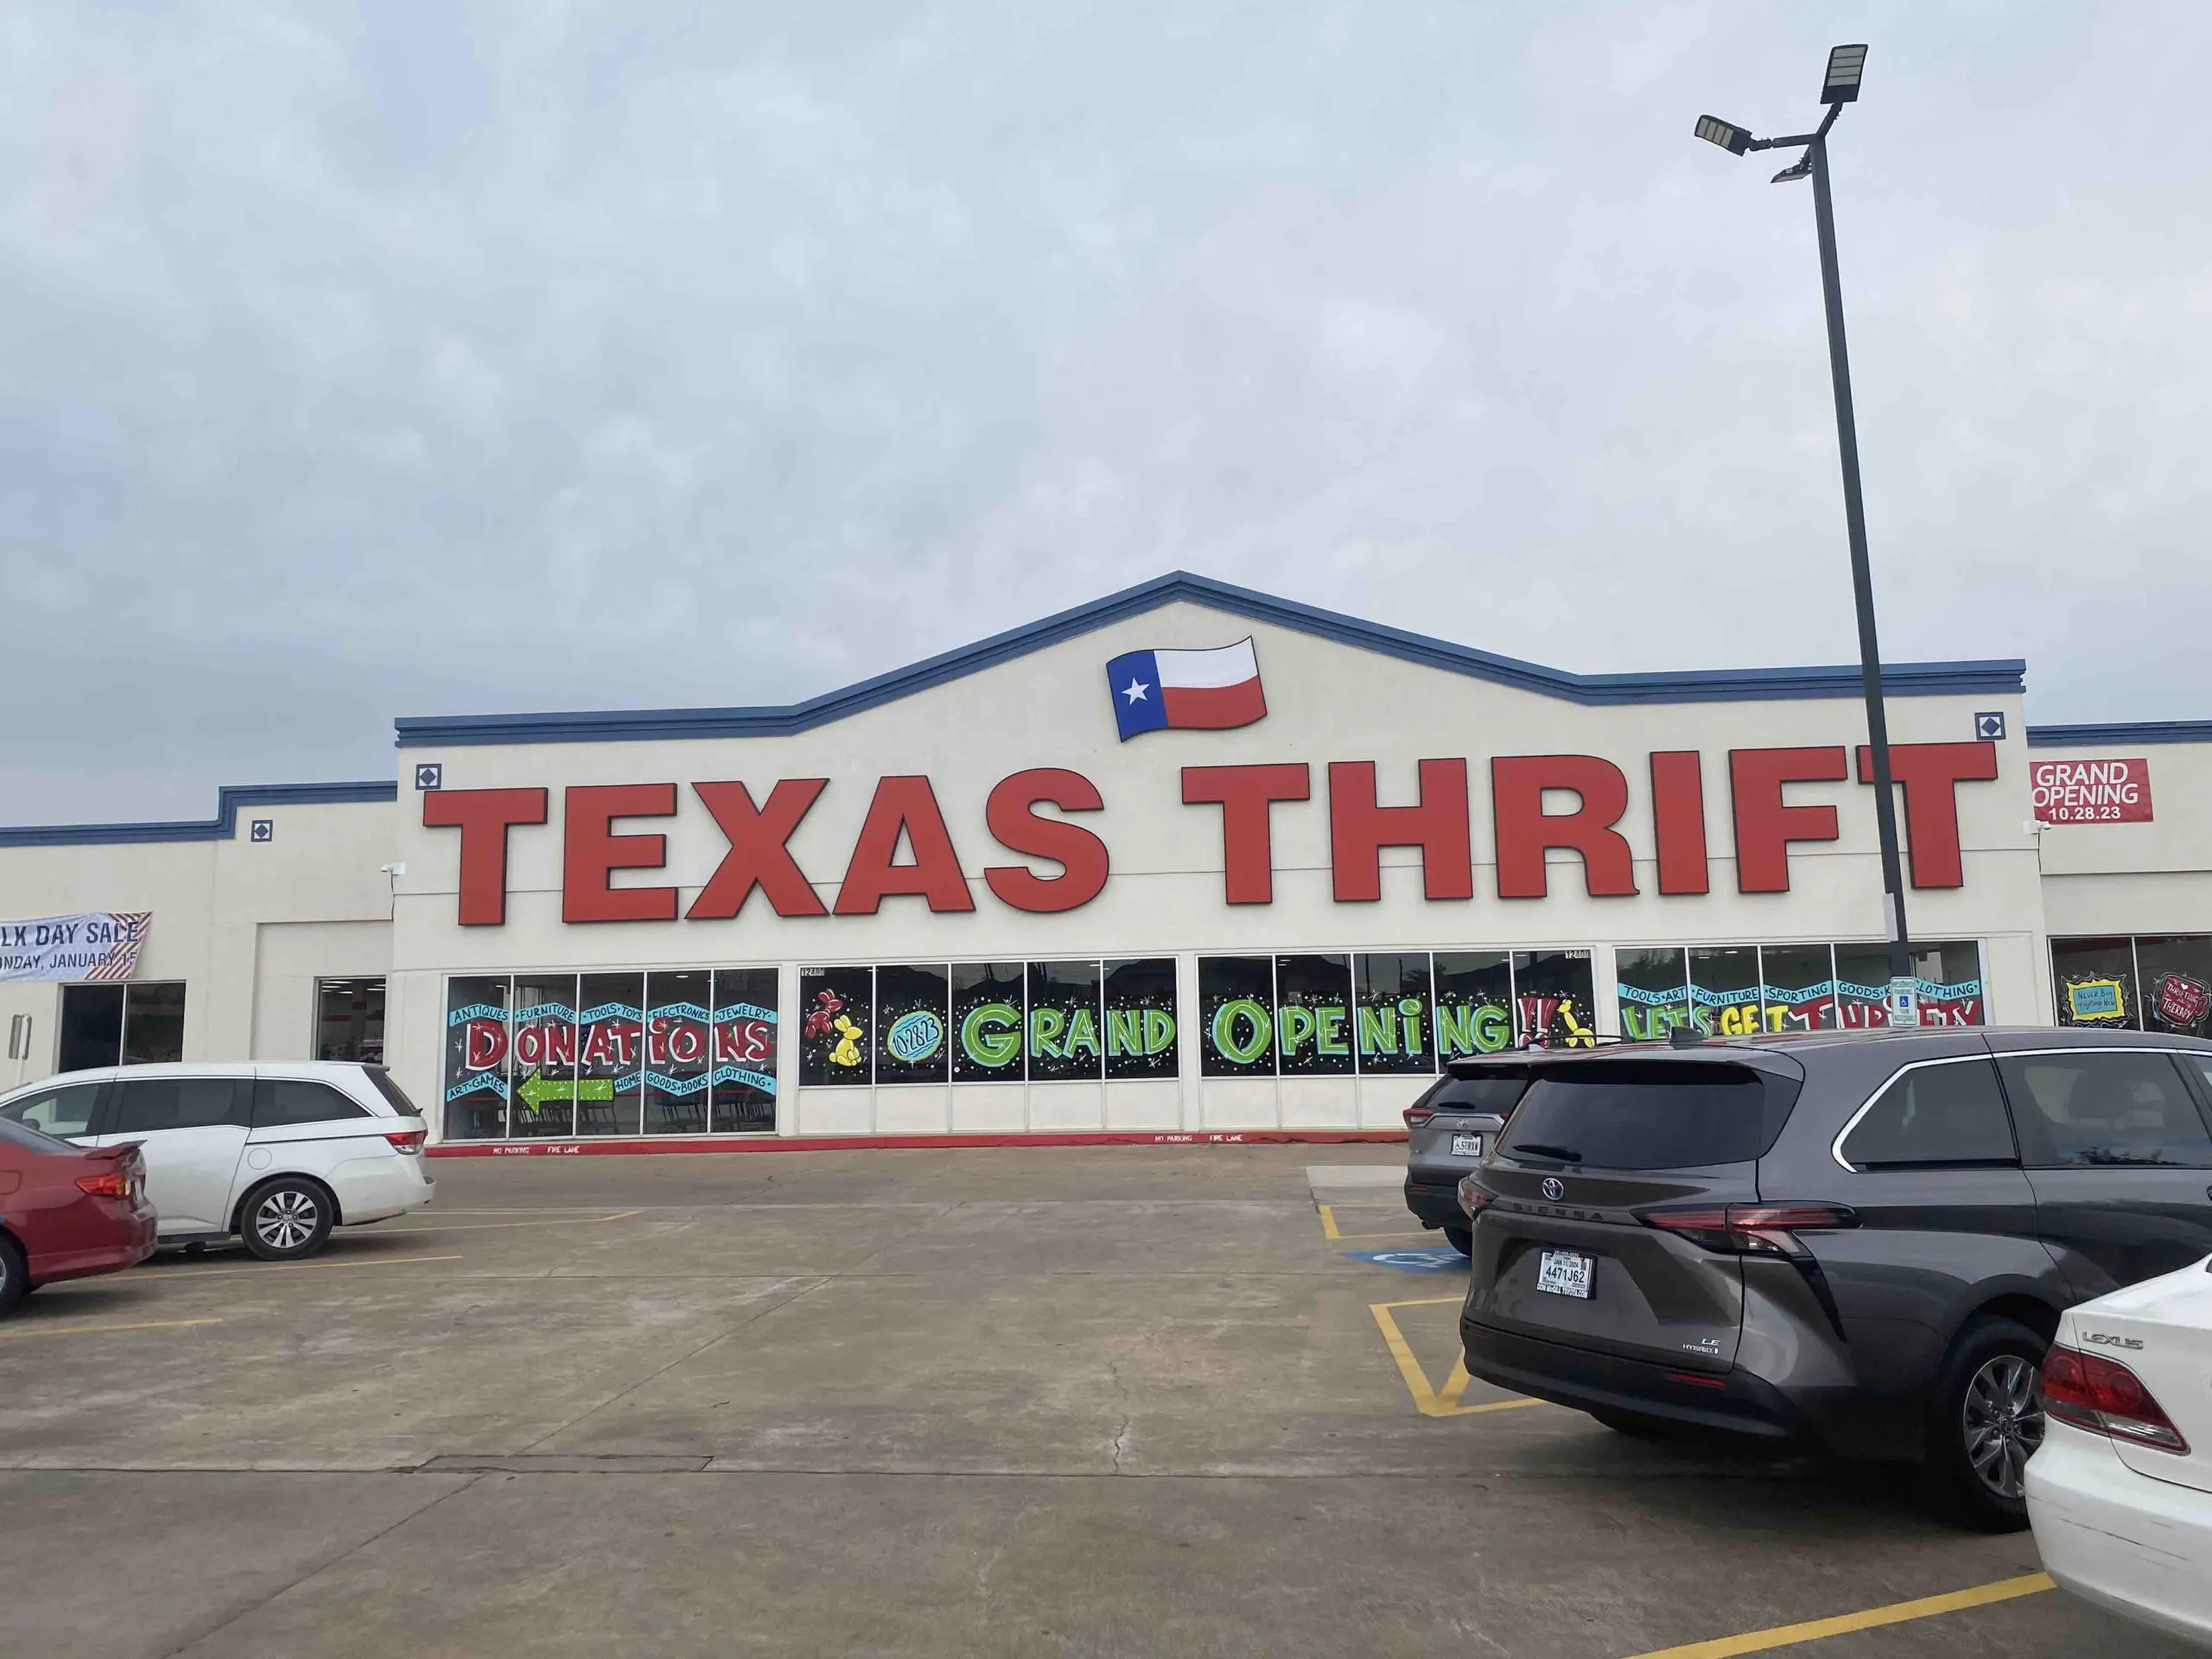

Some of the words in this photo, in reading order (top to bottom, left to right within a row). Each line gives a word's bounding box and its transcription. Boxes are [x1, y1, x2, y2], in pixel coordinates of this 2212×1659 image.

[2036, 762, 2128, 786] GRAND
[2032, 784, 2139, 807] OPENING
[2049, 806, 2121, 820] 10.28.23
[423, 767, 1110, 926] TEXAS
[1180, 741, 1999, 906] THRIFT
[35, 923, 79, 946] DAY
[86, 921, 139, 944] SALE
[49, 952, 114, 969] JANUARY
[1624, 986, 1660, 1003] TOOLS
[1665, 987, 1685, 1002] ART
[1697, 988, 1758, 1005] FURNITURE
[1770, 982, 1828, 1002] SPORTING
[1839, 982, 1880, 998] GOODS
[2167, 982, 2199, 1003] THRIFTING
[454, 1004, 508, 1023] ANTIQUES
[520, 1004, 575, 1021] FURNITURE
[587, 1003, 617, 1020] TOOLS
[621, 1005, 643, 1021] TOYS
[719, 1005, 767, 1020] JEWELRY
[1720, 1004, 1789, 1035] GET
[2163, 997, 2192, 1020] THERAPY
[962, 1002, 1176, 1067] GRAND
[449, 1084, 468, 1097] ART
[474, 1076, 505, 1094] GAMES
[617, 1075, 641, 1090] HOME
[648, 1071, 677, 1090] GOODS
[681, 1074, 709, 1093] BOOKS
[714, 1068, 766, 1087] CLOTHING
[1512, 1203, 1604, 1221] SIENNA
[1545, 1265, 1585, 1283] 4471J62
[1682, 1344, 1713, 1353] HYBRID
[2082, 1332, 2143, 1350] LEXUS
